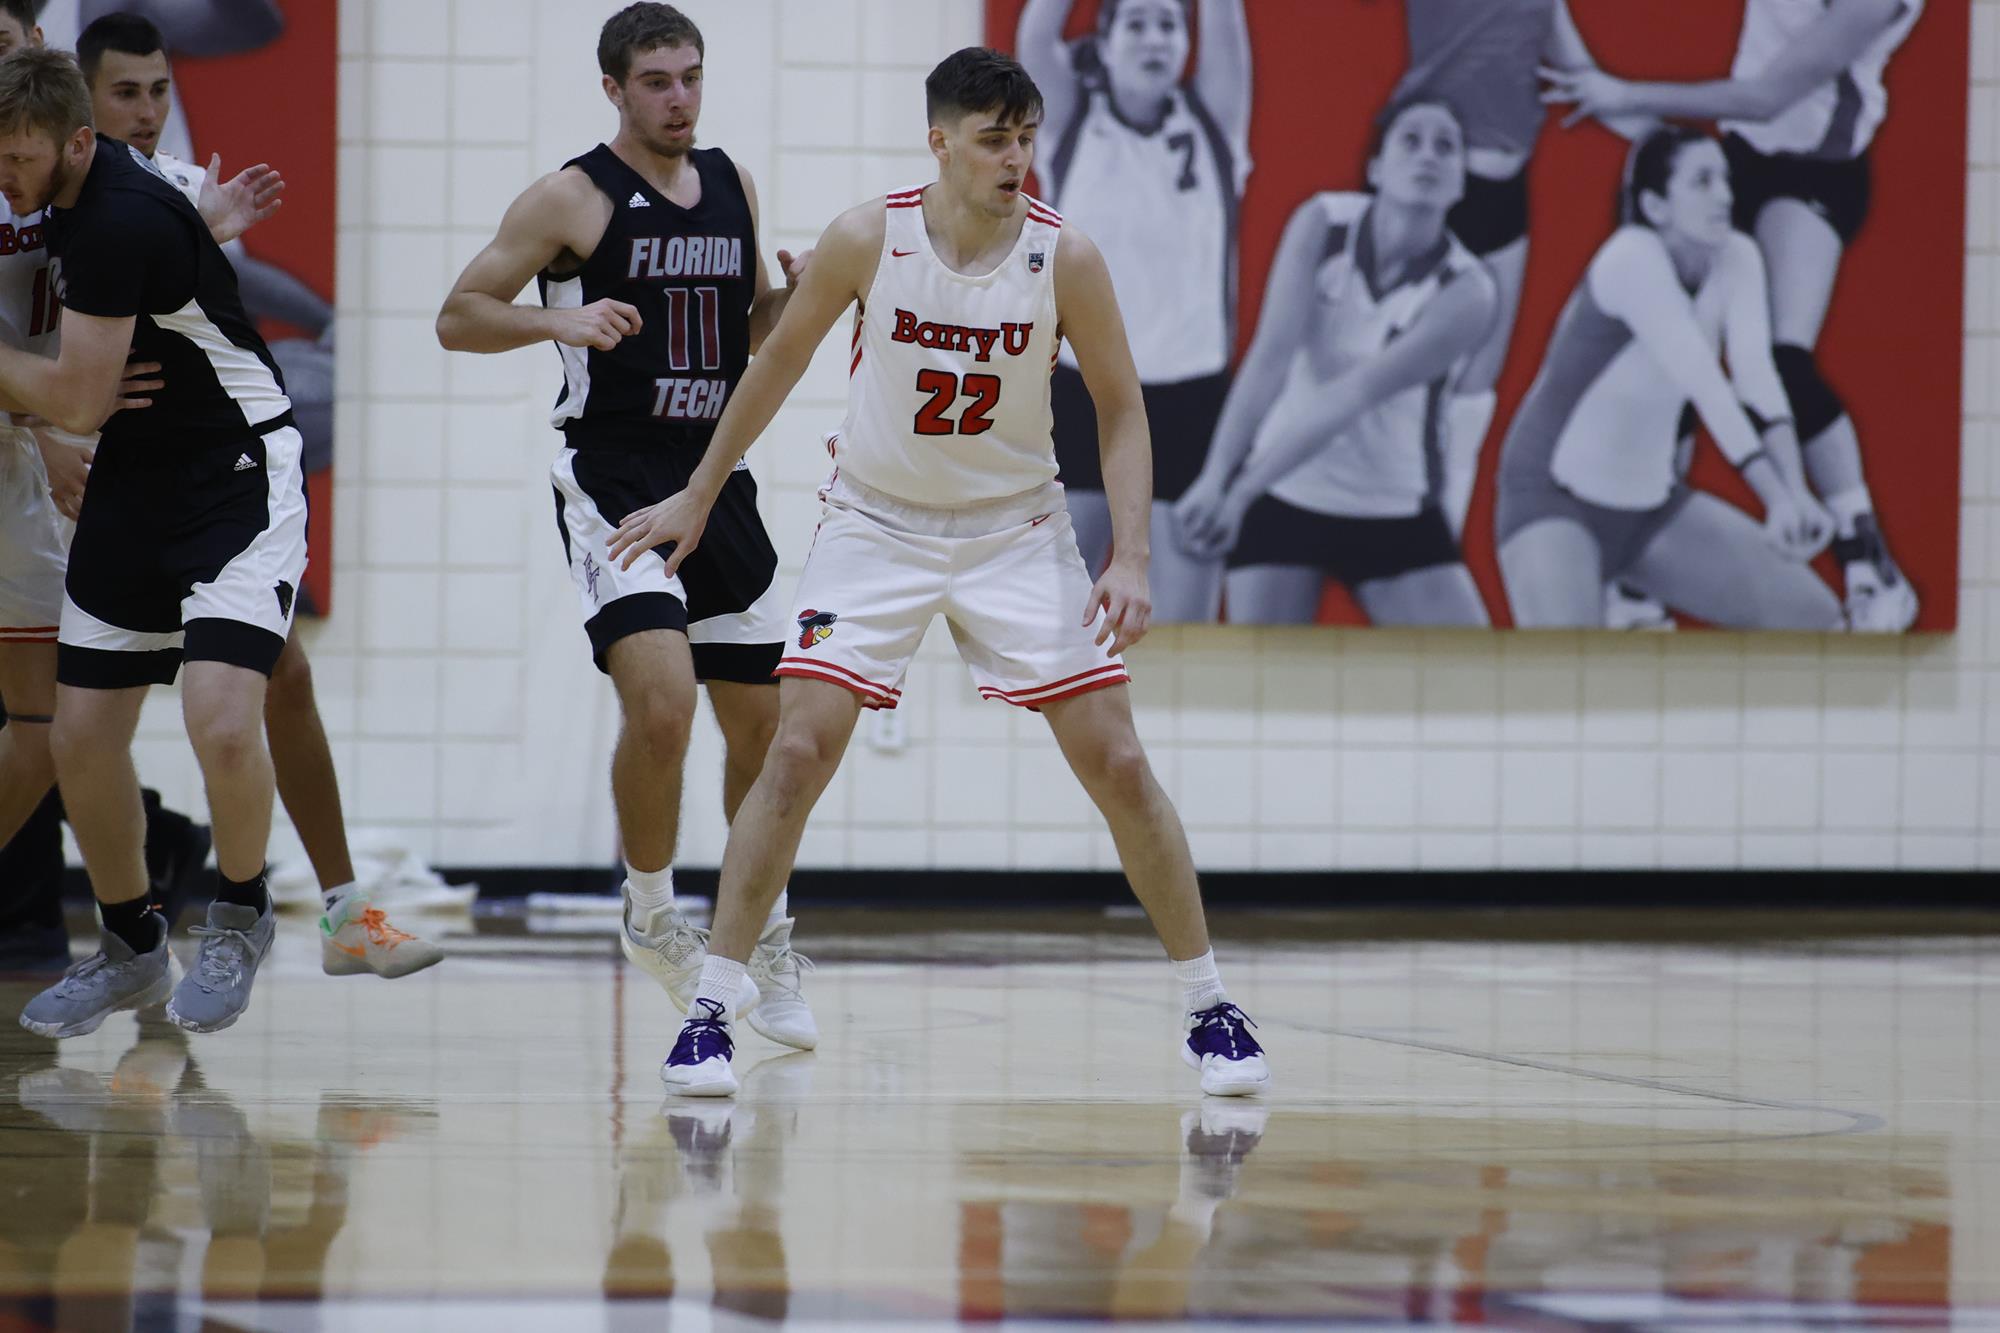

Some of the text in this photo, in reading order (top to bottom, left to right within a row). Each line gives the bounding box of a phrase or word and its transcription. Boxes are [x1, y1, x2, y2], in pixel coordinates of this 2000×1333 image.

[1168, 132, 1196, 191] 7
[627, 236, 742, 279] FLORIDA
[664, 287, 720, 370] 11
[891, 308, 1034, 362] Barry U
[651, 378, 727, 419] TECH
[914, 368, 1001, 435] 22
